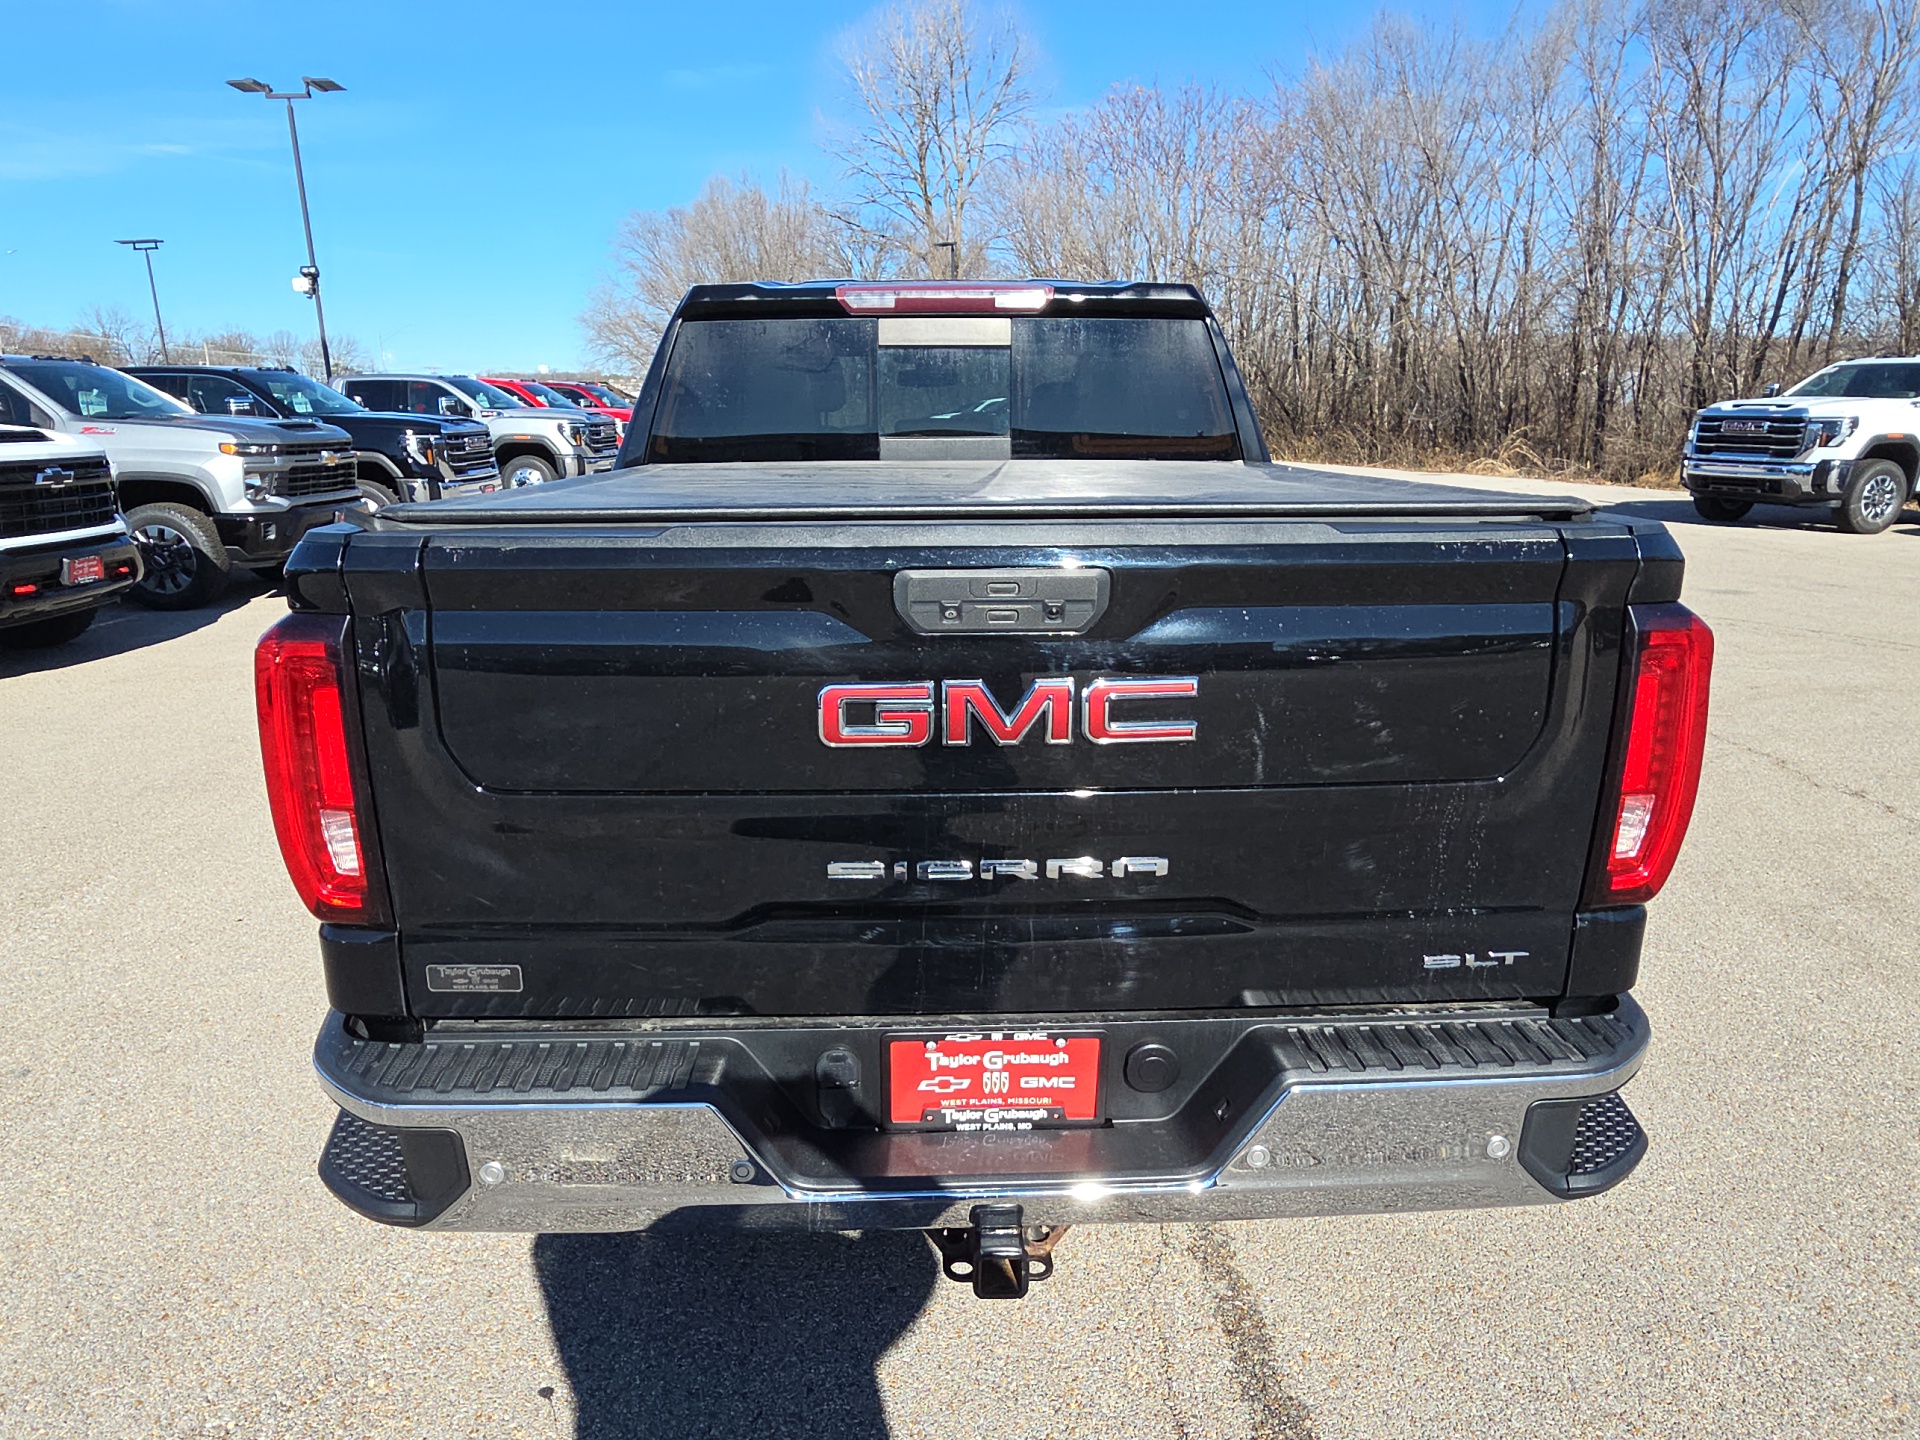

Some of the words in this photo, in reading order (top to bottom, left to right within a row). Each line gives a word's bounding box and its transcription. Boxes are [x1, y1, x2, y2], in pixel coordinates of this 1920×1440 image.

[818, 677, 1198, 748] GMC
[827, 856, 1169, 880] SIERRA
[1423, 951, 1530, 968] SLT
[437, 966, 466, 978] Taylor
[467, 966, 511, 977] Grubaugh
[1013, 1032, 1048, 1041] GMC
[925, 1051, 981, 1071] Taylor
[982, 1050, 1069, 1070] Grubaugh
[1020, 1076, 1076, 1089] GMC
[940, 1098, 967, 1107] WEST
[969, 1097, 1005, 1106] PLAINS,
[1007, 1096, 1053, 1105] MISSOURI
[941, 1108, 983, 1124] Taylor
[984, 1107, 1048, 1122] Grubaugh
[956, 1123, 981, 1132] WEST
[1017, 1122, 1033, 1131] MO
